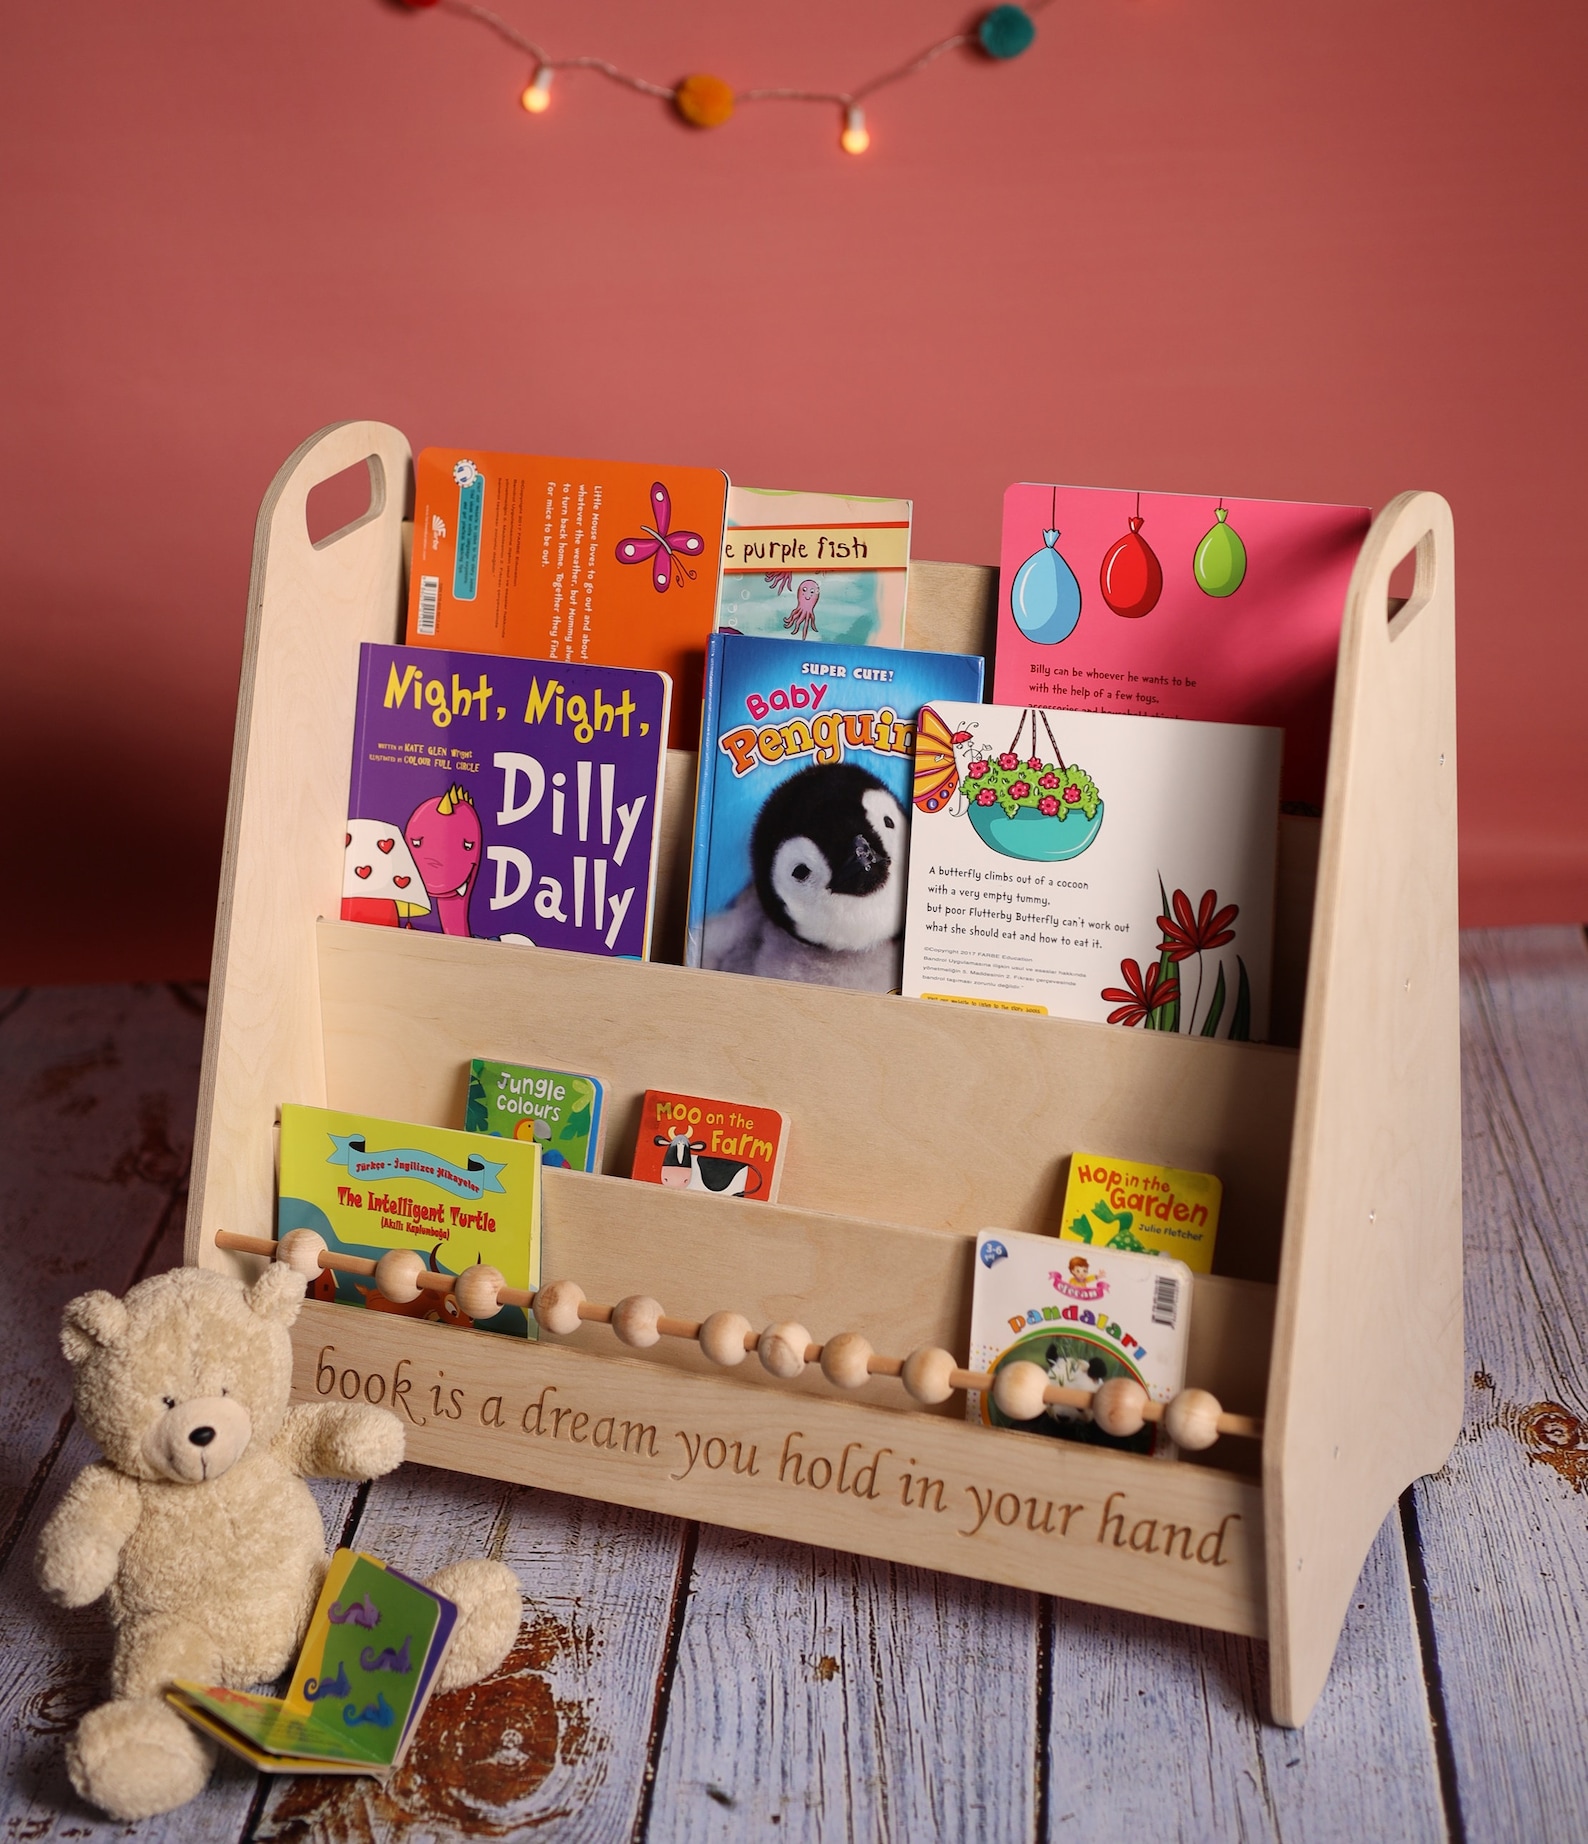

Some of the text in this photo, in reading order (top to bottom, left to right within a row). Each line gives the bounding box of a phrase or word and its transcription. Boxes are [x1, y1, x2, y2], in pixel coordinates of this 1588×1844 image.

[548, 482, 556, 496] for
[563, 483, 571, 493] to
[593, 486, 602, 510] Little
[546, 499, 554, 520] mice
[562, 496, 570, 515] turn
[576, 484, 587, 526] whatever
[545, 523, 552, 532] to
[560, 518, 569, 539] back
[575, 530, 584, 544] the
[591, 513, 599, 540] Mouse
[544, 536, 552, 546] be
[743, 538, 808, 563] purple
[817, 536, 867, 558] fish
[588, 544, 598, 566] loves
[588, 570, 595, 579] to
[553, 573, 564, 612] Together
[570, 590, 579, 605] but
[584, 582, 593, 594] go
[550, 616, 561, 636] they
[565, 608, 576, 642] Mummy
[583, 615, 591, 631] and
[550, 640, 559, 658] find
[581, 634, 590, 659] about
[802, 662, 894, 682] SUPER CUTE!
[1031, 664, 1196, 687] Billy can be whoever he wants to be
[383, 660, 650, 744] Night, Night,
[746, 683, 828, 721] Baby
[1029, 683, 1049, 693] with
[1052, 684, 1067, 694] the
[1071, 685, 1090, 699] help
[1094, 689, 1104, 698] of
[1106, 690, 1112, 699] a
[1115, 690, 1132, 700] few
[405, 744, 424, 753] KATE
[428, 747, 447, 756] GLEN
[404, 756, 431, 766] COLOUR
[434, 759, 451, 770] FULL
[456, 762, 480, 772] CIRCLE
[493, 752, 647, 867] Dilly
[928, 865, 1089, 891] A butterfly climbs out of a cocoon
[487, 846, 635, 949] Dally
[928, 884, 947, 894] with
[950, 886, 956, 896] a
[960, 890, 979, 900] very
[983, 892, 1012, 903] empty
[927, 903, 1129, 932] but poor Flutterby Butterfly can't work out
[925, 922, 1103, 949] what she should eat and how to eat it.
[496, 1071, 566, 1102] Jungle
[496, 1094, 561, 1122] Colours
[706, 1114, 723, 1124] on
[729, 1113, 753, 1129] the
[712, 1129, 773, 1162] Farm
[1078, 1165, 1170, 1193] Hop in the
[338, 1187, 496, 1232] The Intelligent Turtle
[1109, 1187, 1208, 1227] Garden
[1139, 1224, 1203, 1242] Julie Fletcher
[986, 1243, 1003, 1255] 3-6
[316, 1345, 1242, 1567] book is a dream you hold in your hand
